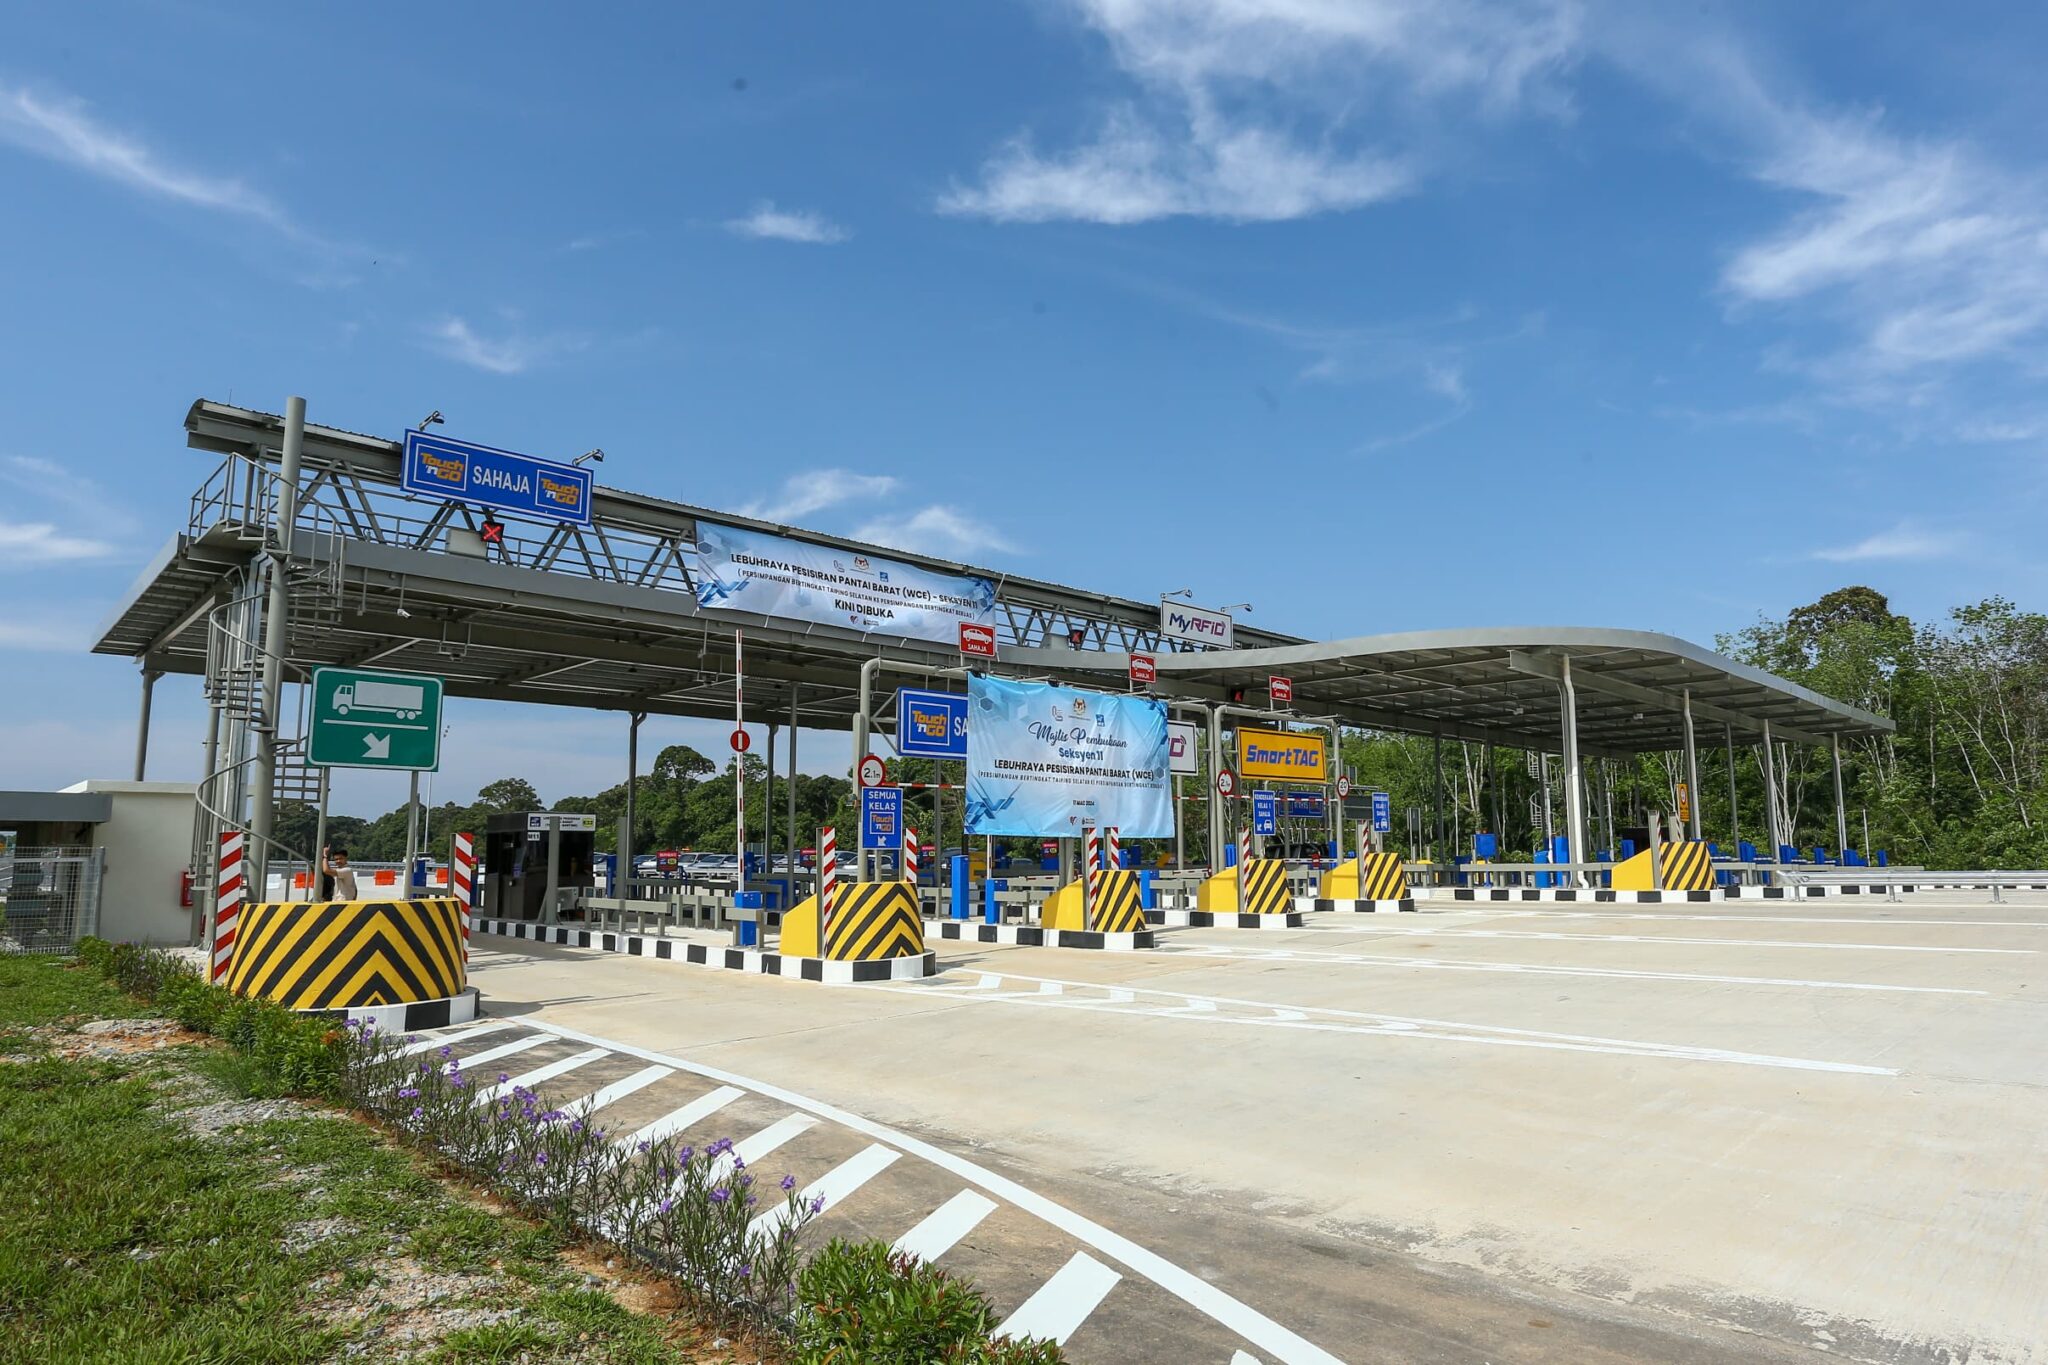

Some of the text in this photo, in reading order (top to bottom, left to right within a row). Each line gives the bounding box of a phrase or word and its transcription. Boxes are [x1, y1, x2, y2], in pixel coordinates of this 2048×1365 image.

[420, 452, 464, 470] Touch
[472, 465, 530, 494] SAHAJA
[541, 478, 579, 496] Touch
[731, 553, 790, 572] LEBUHRAYA
[791, 565, 837, 582] PESISIRAN
[838, 575, 871, 590] PANTAI
[872, 583, 900, 596] BARAT
[902, 586, 931, 601] (WCE)
[938, 594, 972, 608] SEKSYEN
[742, 570, 791, 584] PERSIMPANGAN
[791, 578, 825, 592] BERTINGKAT
[835, 599, 894, 619] KINI DIBUKA
[967, 643, 988, 652] SAHAJA
[912, 710, 947, 725] Touch
[1028, 721, 1128, 748] Majlis Pembukaan
[1059, 747, 1095, 762] Seksyen
[1246, 744, 1319, 767] SmartTAG
[994, 759, 1154, 781] LEBUHRAYA PESISIRAN PANTAI BARAT (WCE)
[868, 791, 897, 800] SEMUA
[868, 802, 896, 811] KELAS
